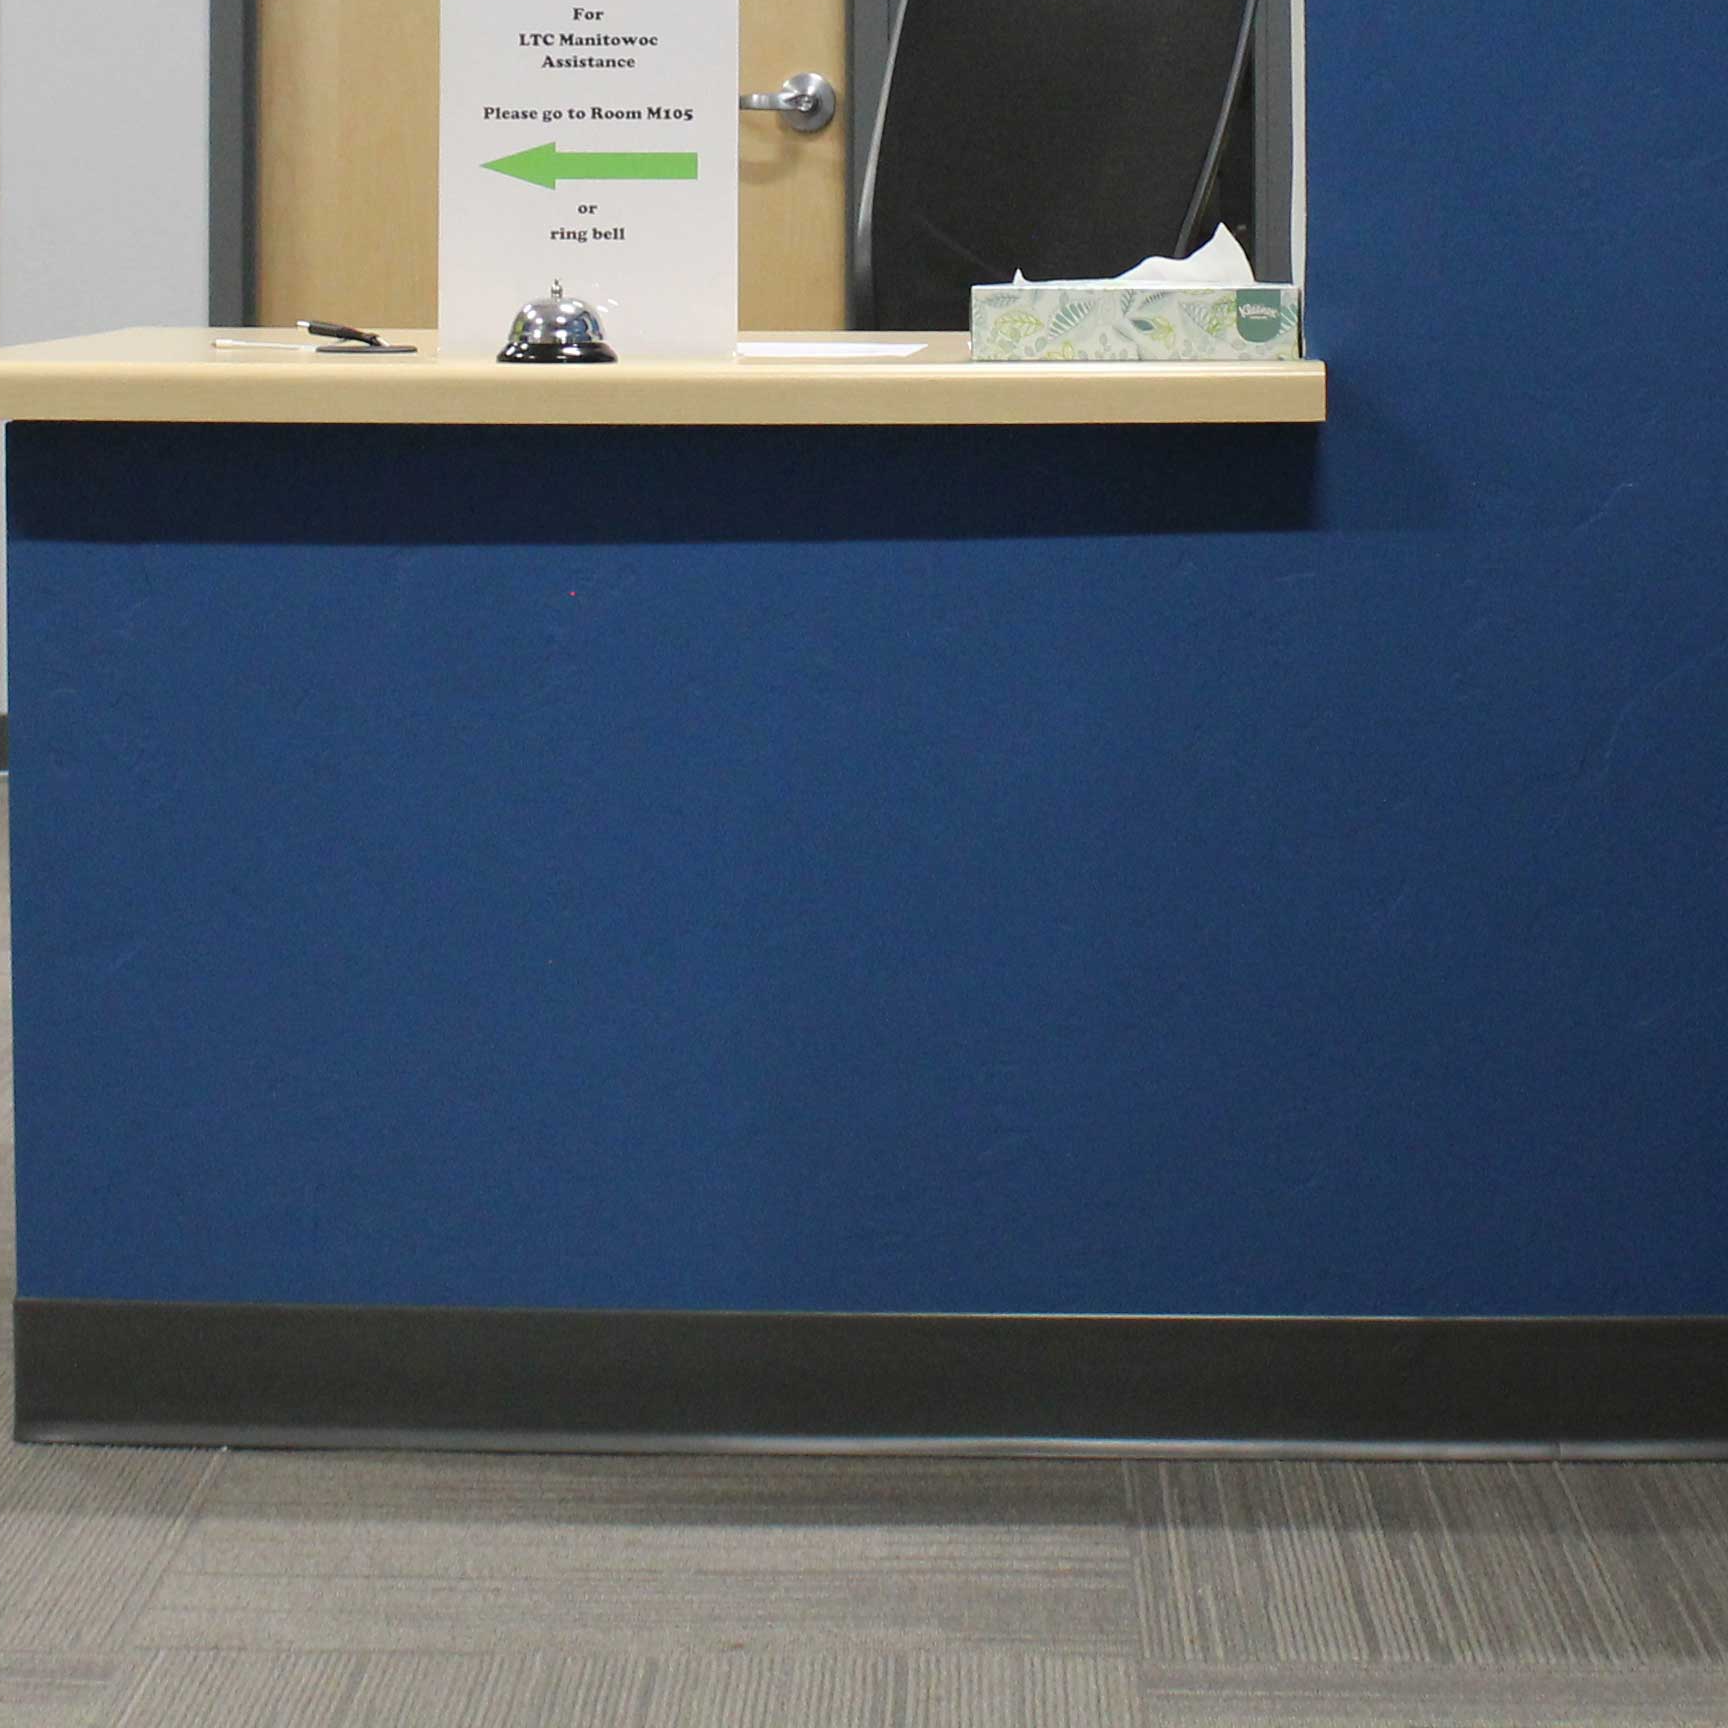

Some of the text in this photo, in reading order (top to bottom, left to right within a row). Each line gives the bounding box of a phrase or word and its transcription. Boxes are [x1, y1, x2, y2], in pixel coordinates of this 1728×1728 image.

[572, 7, 604, 21] For
[519, 33, 659, 47] LTC Manitowoc
[541, 55, 636, 69] Assistance
[483, 106, 694, 123] Please go to Room M105
[577, 204, 598, 215] or
[550, 227, 625, 243] ring bell
